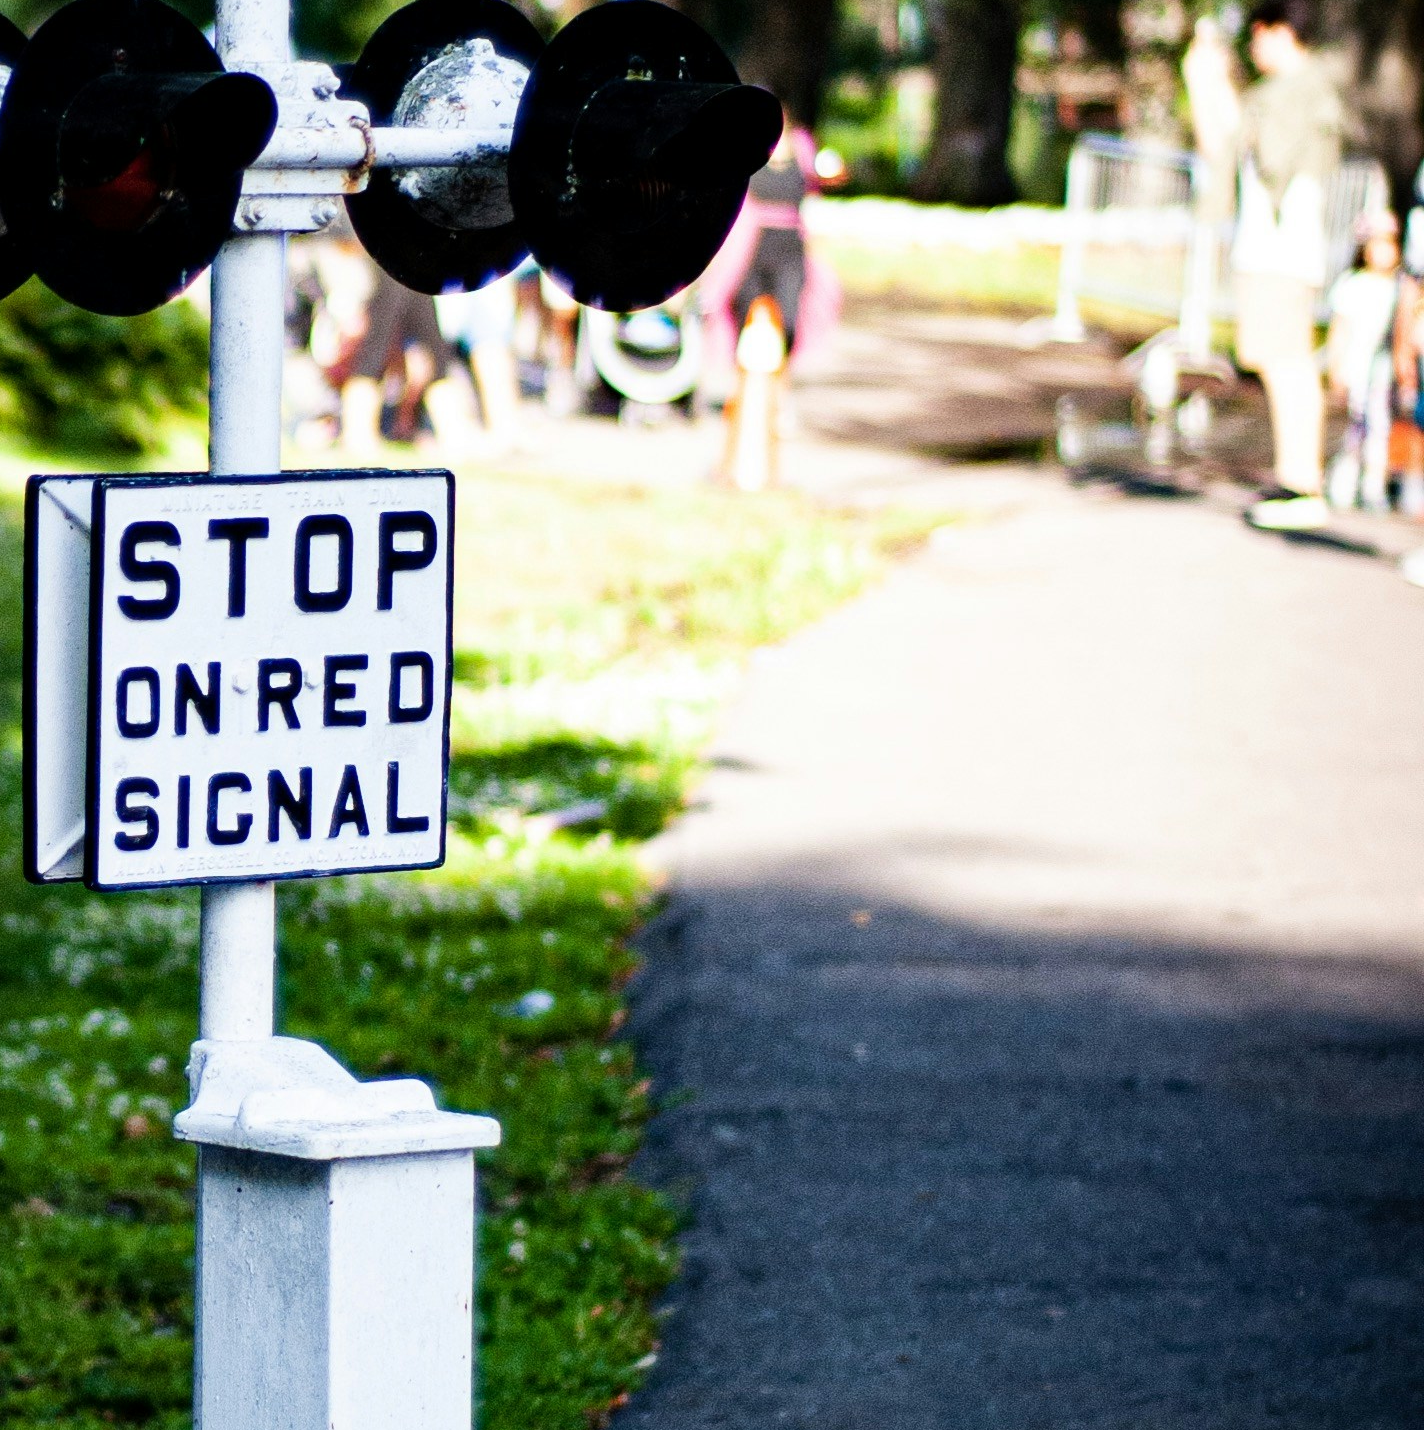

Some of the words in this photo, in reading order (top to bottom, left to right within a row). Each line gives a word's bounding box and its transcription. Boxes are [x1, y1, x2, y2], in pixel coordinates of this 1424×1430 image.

[287, 490, 346, 509] TRAIN
[118, 511, 437, 620] STOP
[116, 662, 221, 738] ON
[258, 651, 433, 731] RED
[115, 762, 429, 851] SIGNAL
